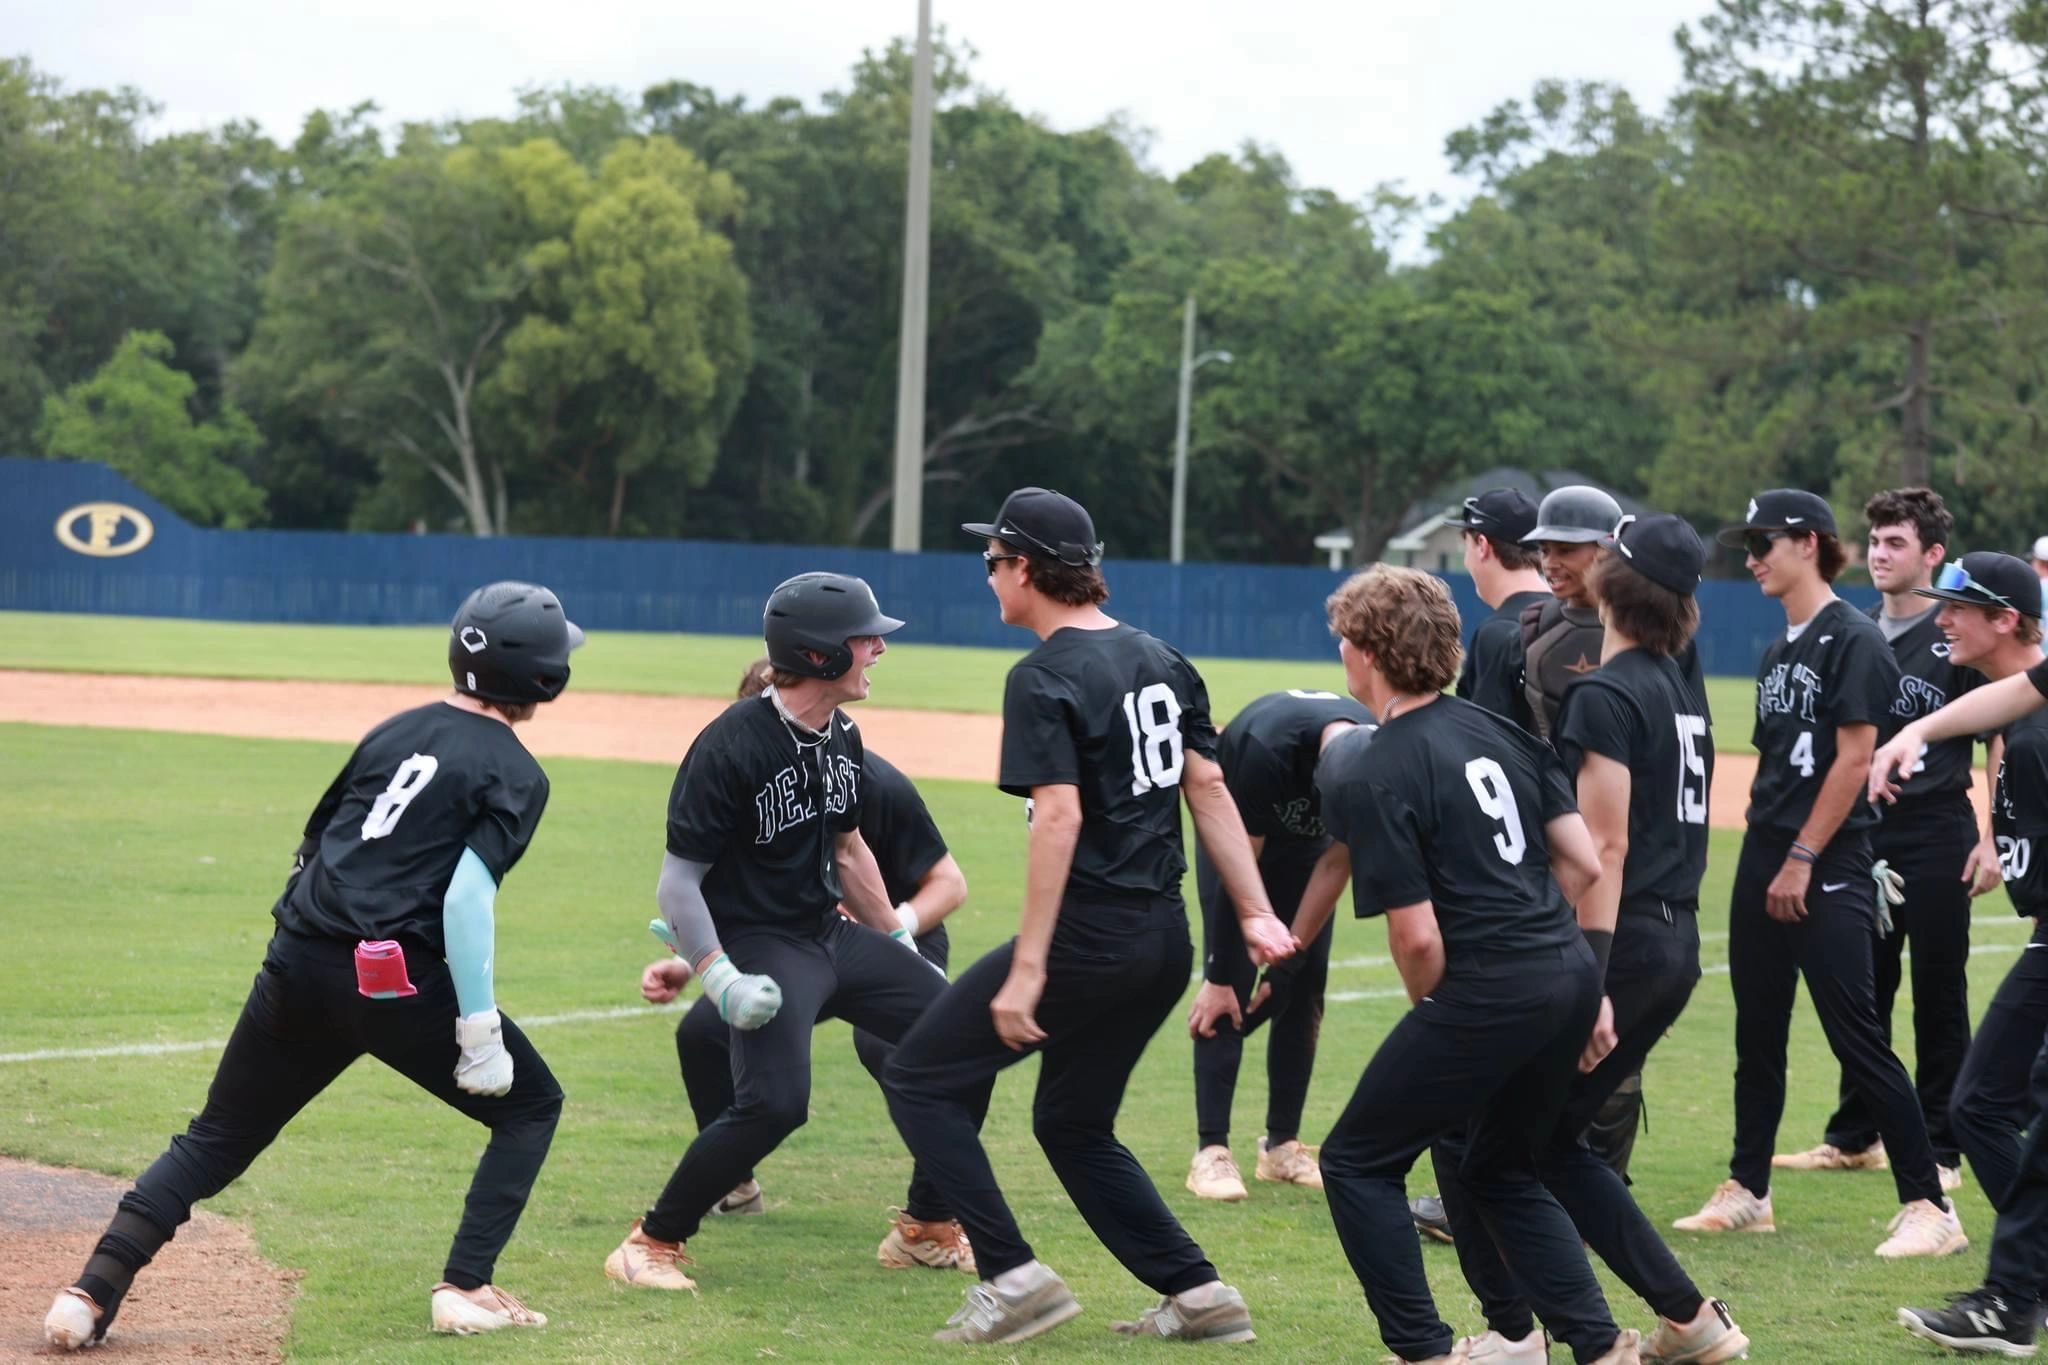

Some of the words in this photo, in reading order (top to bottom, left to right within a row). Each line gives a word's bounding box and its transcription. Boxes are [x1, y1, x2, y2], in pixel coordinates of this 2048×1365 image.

[1123, 683, 1185, 797] 18
[1675, 713, 1707, 824] 15
[1790, 732, 1815, 777] 4
[361, 752, 439, 841] 8
[1465, 756, 1527, 866] 9
[1996, 836, 2031, 882] 20
